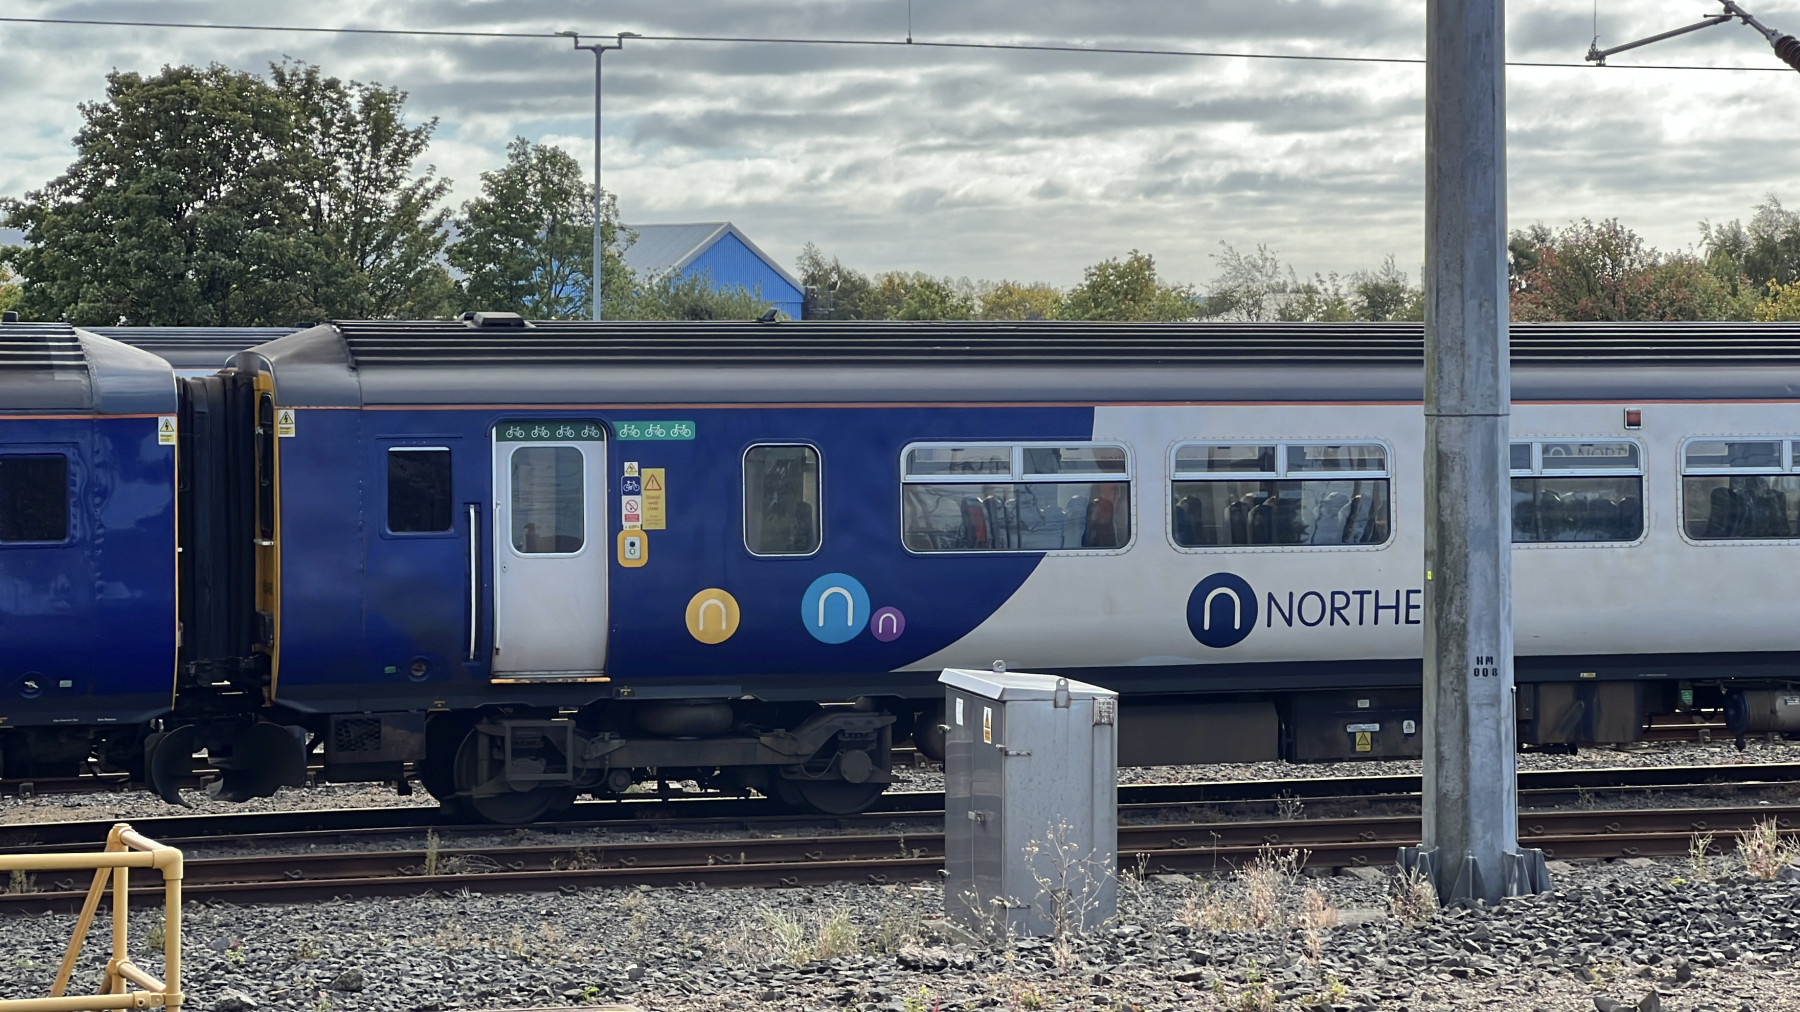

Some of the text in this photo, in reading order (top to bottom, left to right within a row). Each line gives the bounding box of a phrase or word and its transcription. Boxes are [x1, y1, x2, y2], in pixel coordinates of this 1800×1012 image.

[1266, 589, 1422, 628] NORTHE
[1476, 656, 1494, 665] HM
[1474, 668, 1498, 678] 008
